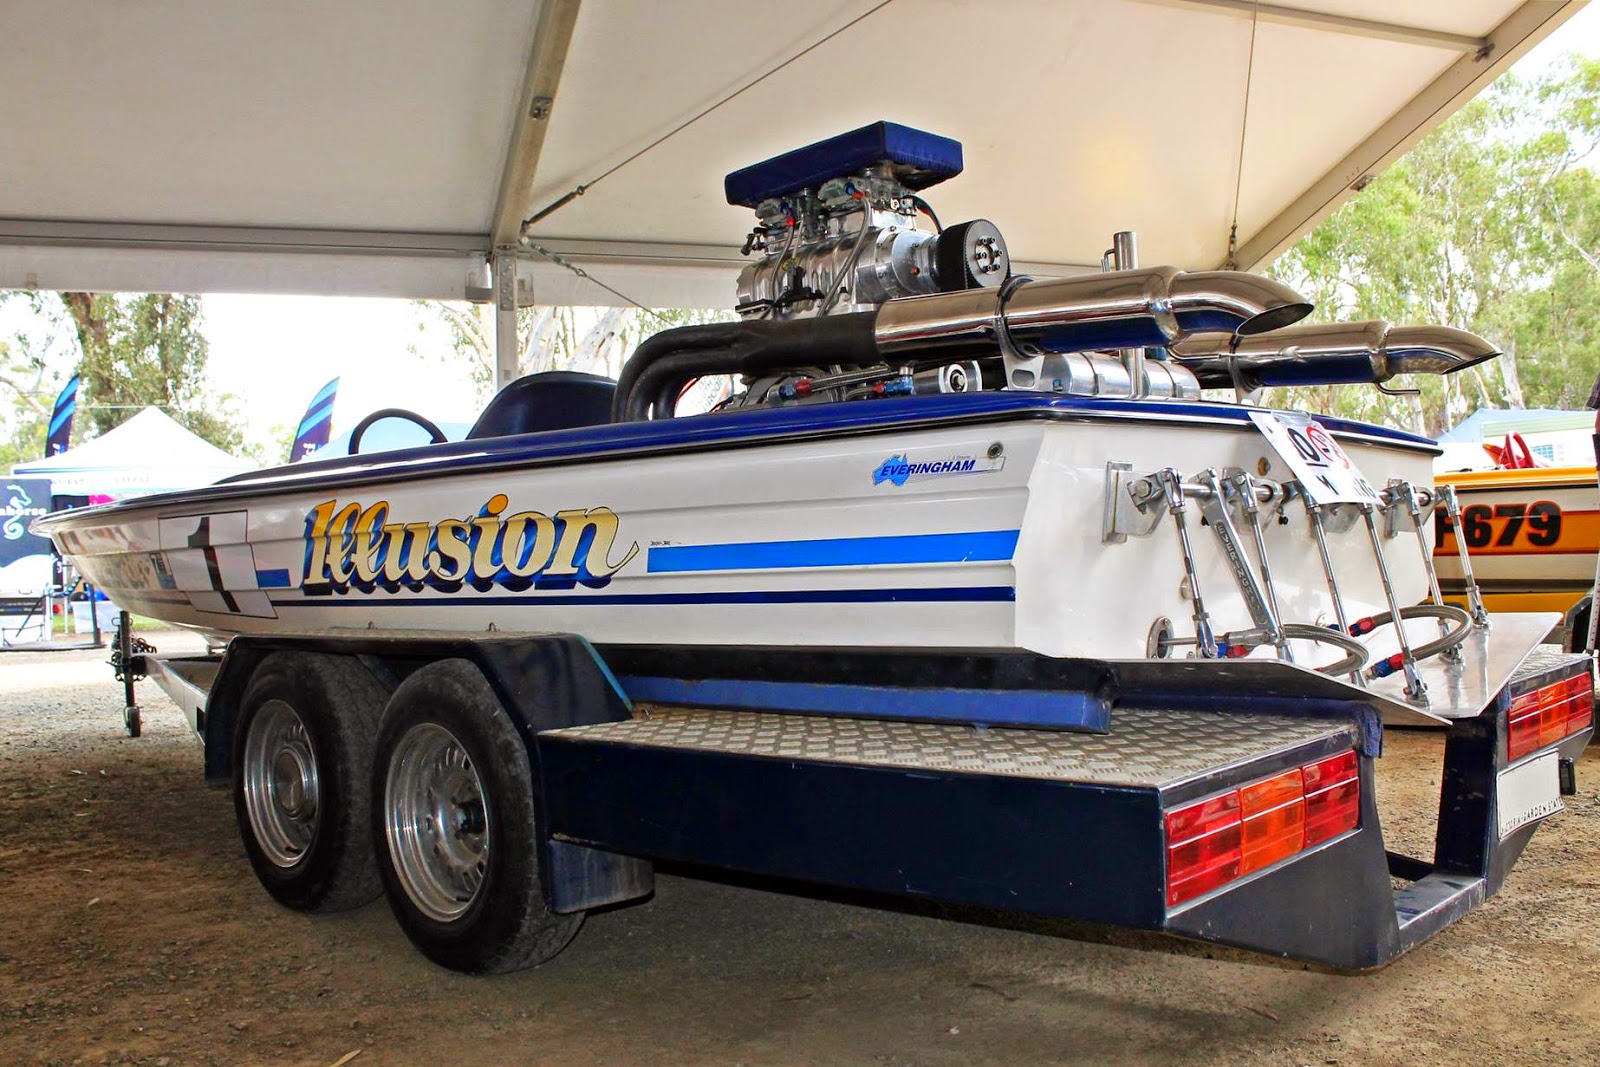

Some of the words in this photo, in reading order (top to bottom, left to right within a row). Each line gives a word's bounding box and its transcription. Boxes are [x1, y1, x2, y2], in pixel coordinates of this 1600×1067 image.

[881, 459, 976, 477] EVERINGHAM
[188, 516, 241, 613] 1
[303, 493, 640, 595] Illusion
[1217, 523, 1264, 613] EVERINGH
